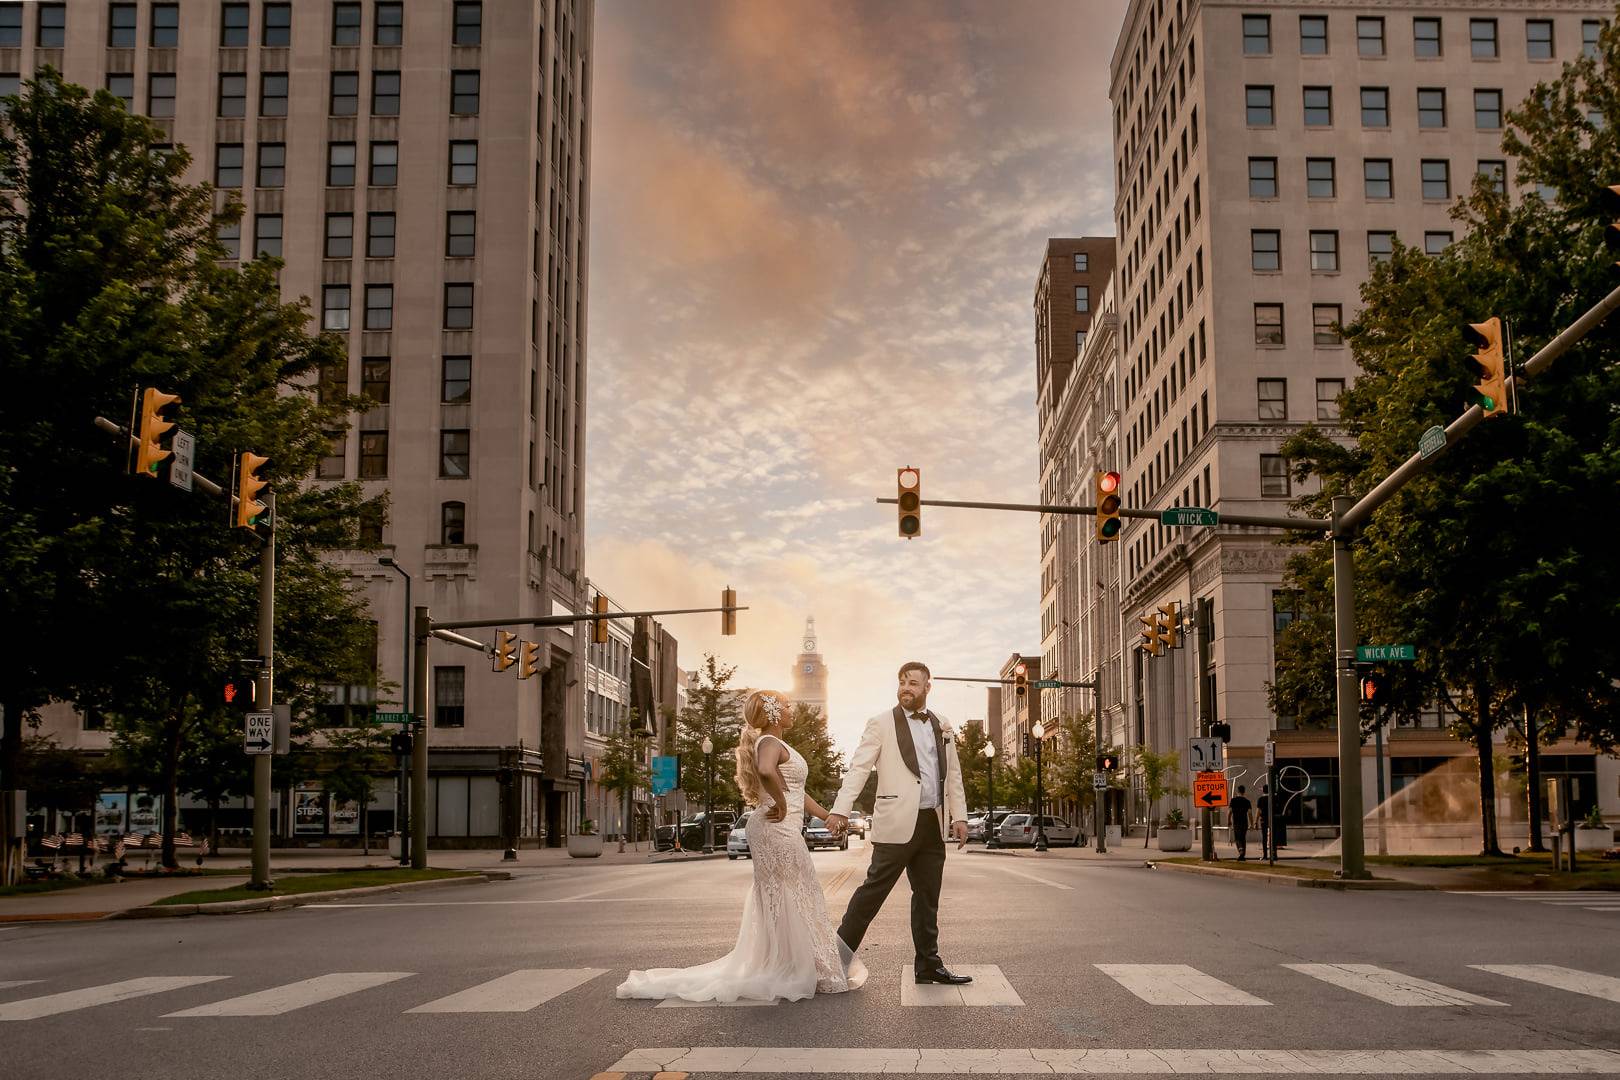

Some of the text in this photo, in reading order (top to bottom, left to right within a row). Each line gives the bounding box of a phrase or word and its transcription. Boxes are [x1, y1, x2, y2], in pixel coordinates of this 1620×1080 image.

[1177, 513, 1202, 524] WICK
[1364, 647, 1386, 659] WICK
[249, 717, 271, 727] ONE
[375, 713, 399, 722] MARKET
[249, 728, 271, 737] WAY
[1197, 784, 1225, 792] DETOUR
[296, 807, 324, 816] STEPS
